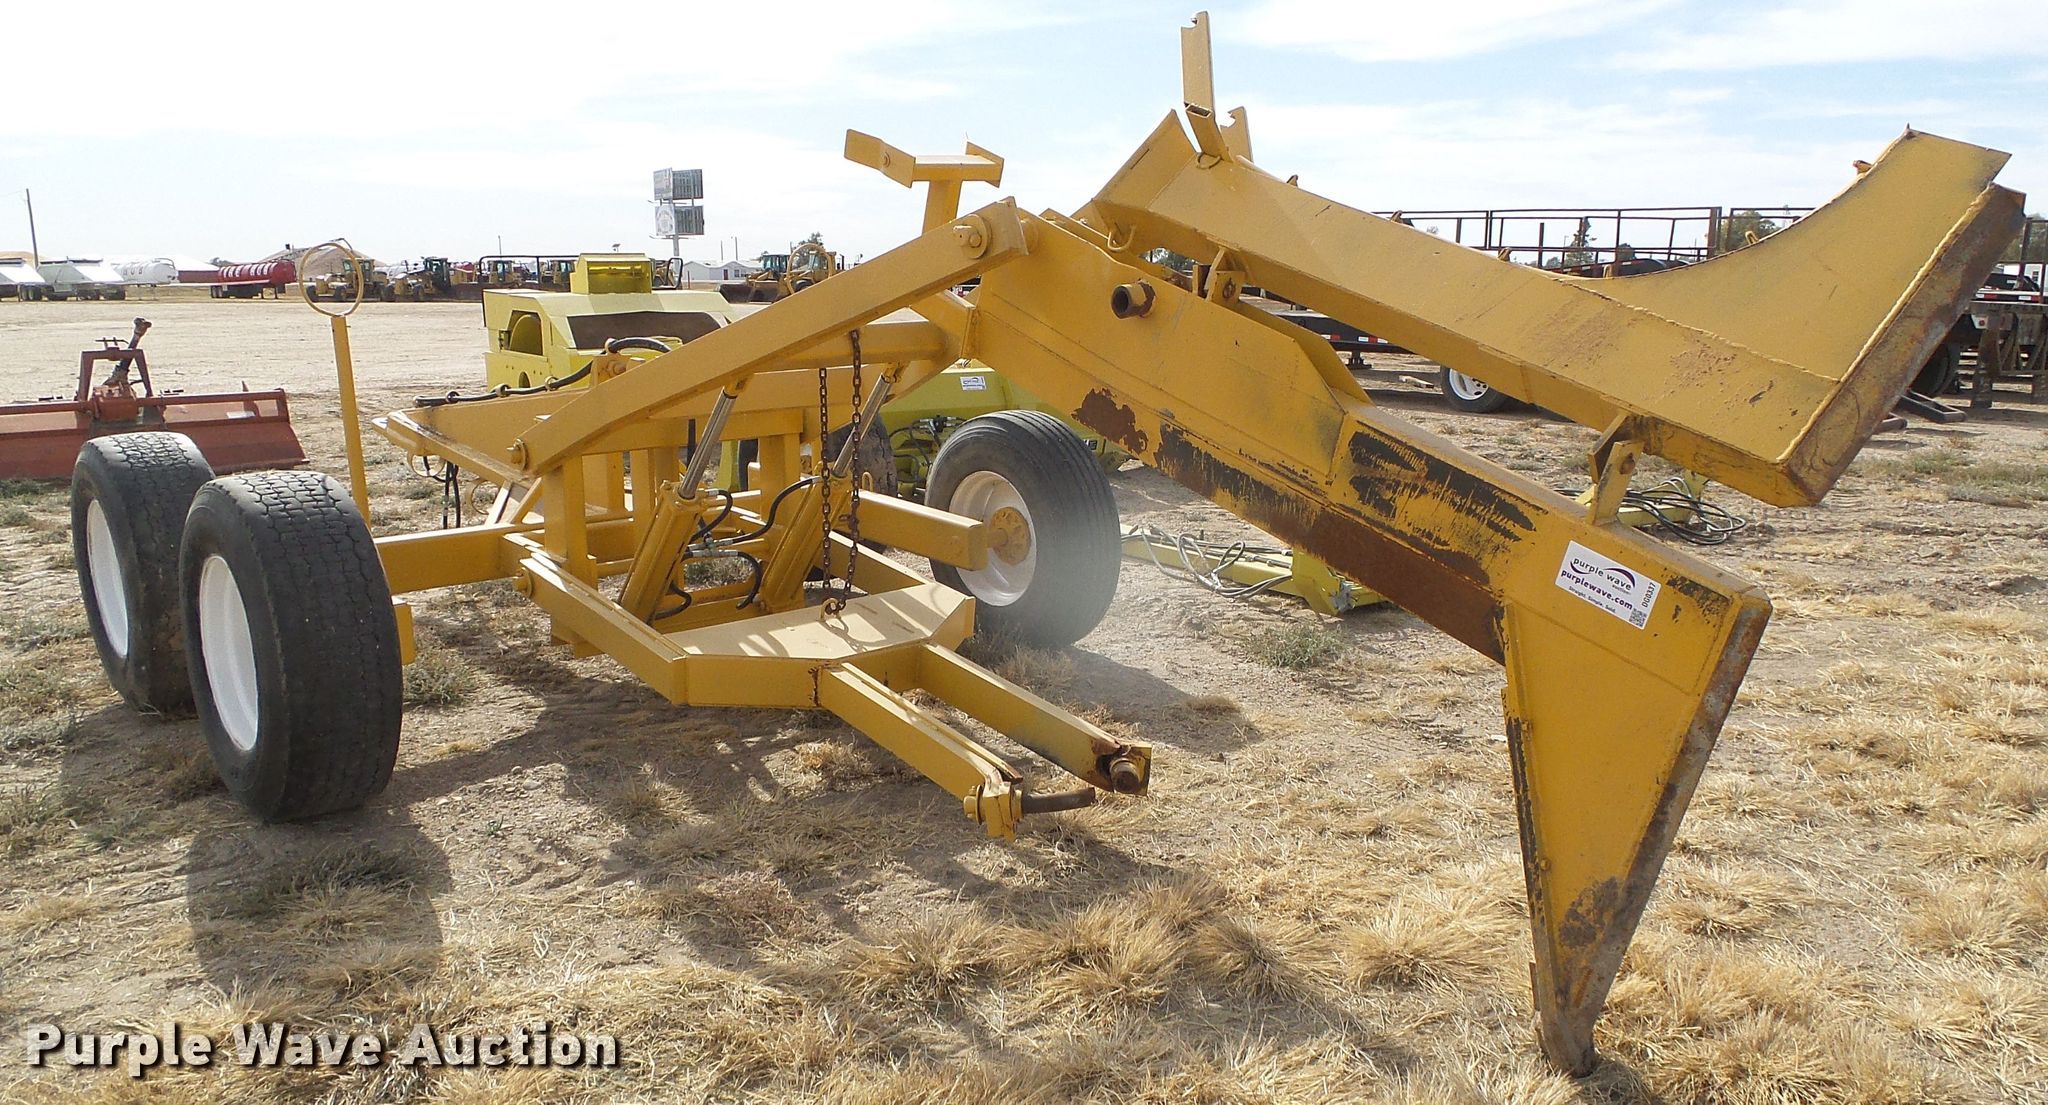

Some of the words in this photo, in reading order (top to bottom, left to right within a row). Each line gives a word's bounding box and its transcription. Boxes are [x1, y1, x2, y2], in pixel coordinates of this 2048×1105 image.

[1560, 570, 1633, 611] purplewave.com
[1573, 558, 1604, 577] purple
[1607, 574, 1632, 590] wave
